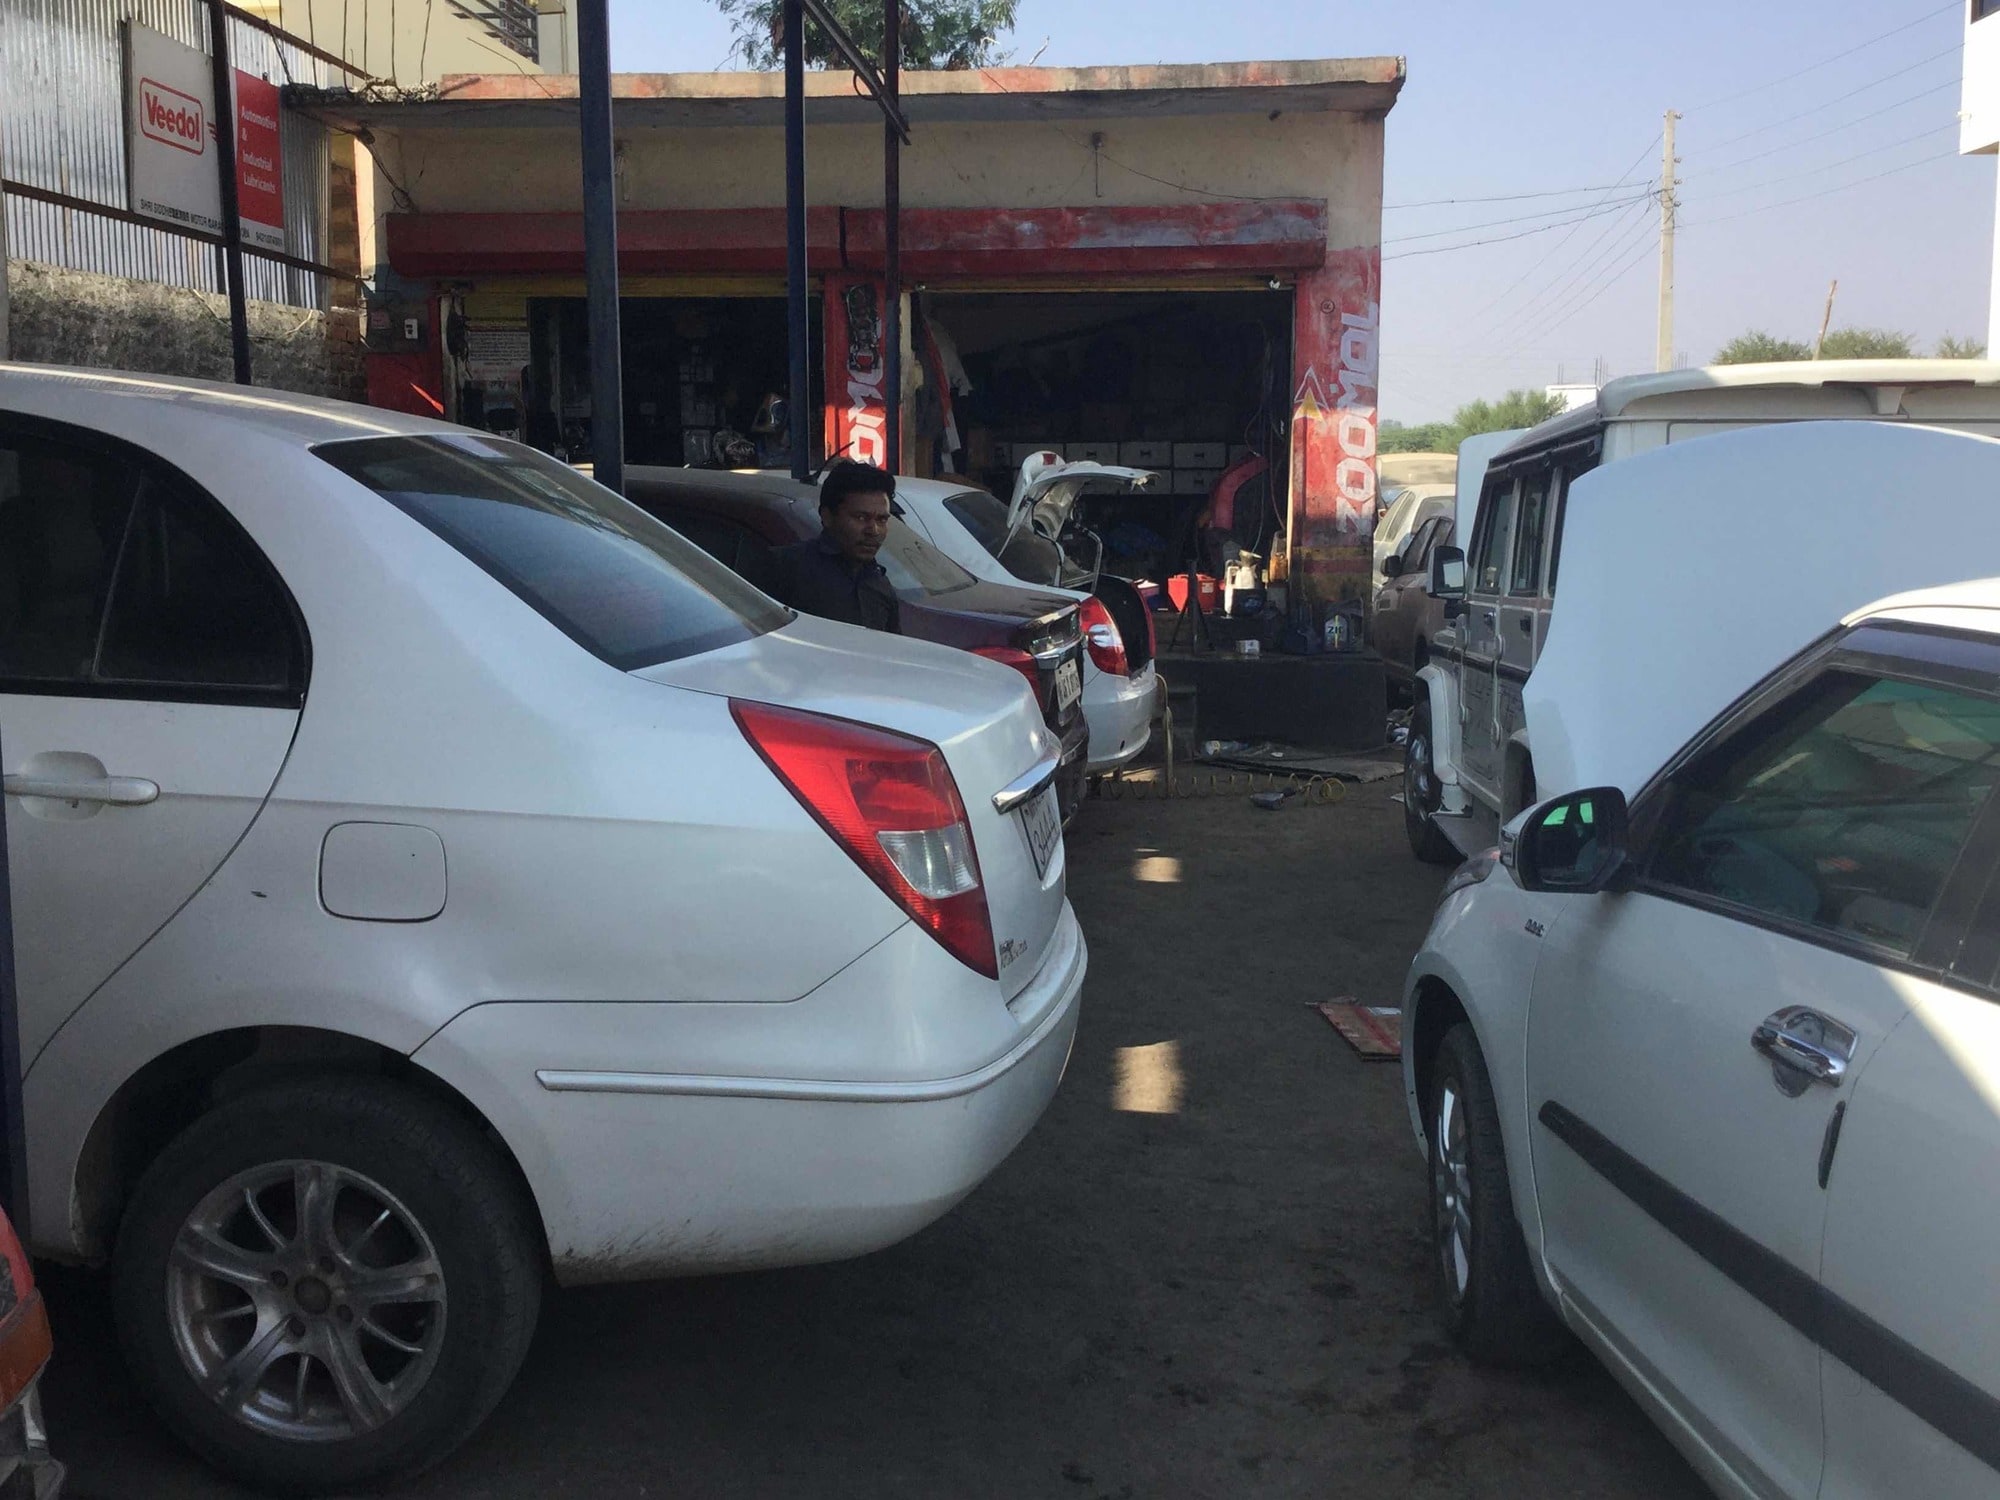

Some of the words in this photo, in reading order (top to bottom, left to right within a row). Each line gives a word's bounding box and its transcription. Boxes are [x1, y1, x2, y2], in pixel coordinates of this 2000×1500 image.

[145, 91, 200, 142] Veedol
[242, 105, 277, 131] Automotive
[242, 127, 248, 141] &
[243, 149, 273, 171] Industrial
[244, 171, 276, 194] Lubricants
[1336, 301, 1379, 537] ZOOMOL
